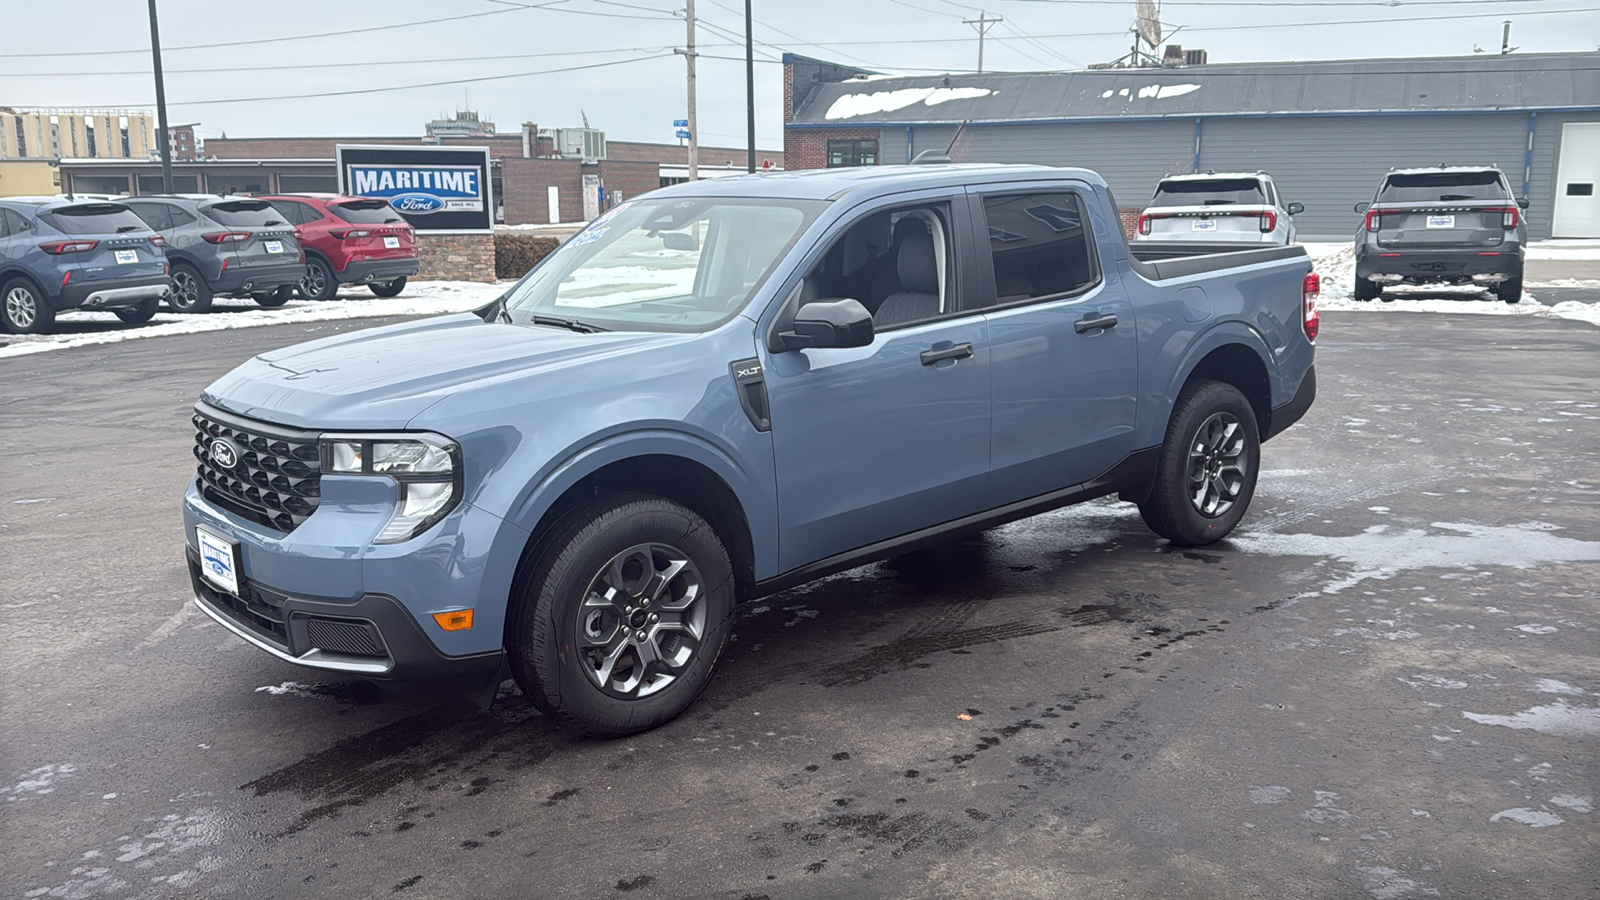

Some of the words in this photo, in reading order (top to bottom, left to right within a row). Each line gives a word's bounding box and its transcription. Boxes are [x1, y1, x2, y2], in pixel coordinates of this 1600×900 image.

[355, 170, 477, 195] MARITIME
[400, 197, 433, 210] Ford
[737, 366, 761, 378] XLT
[214, 443, 232, 465] Ford
